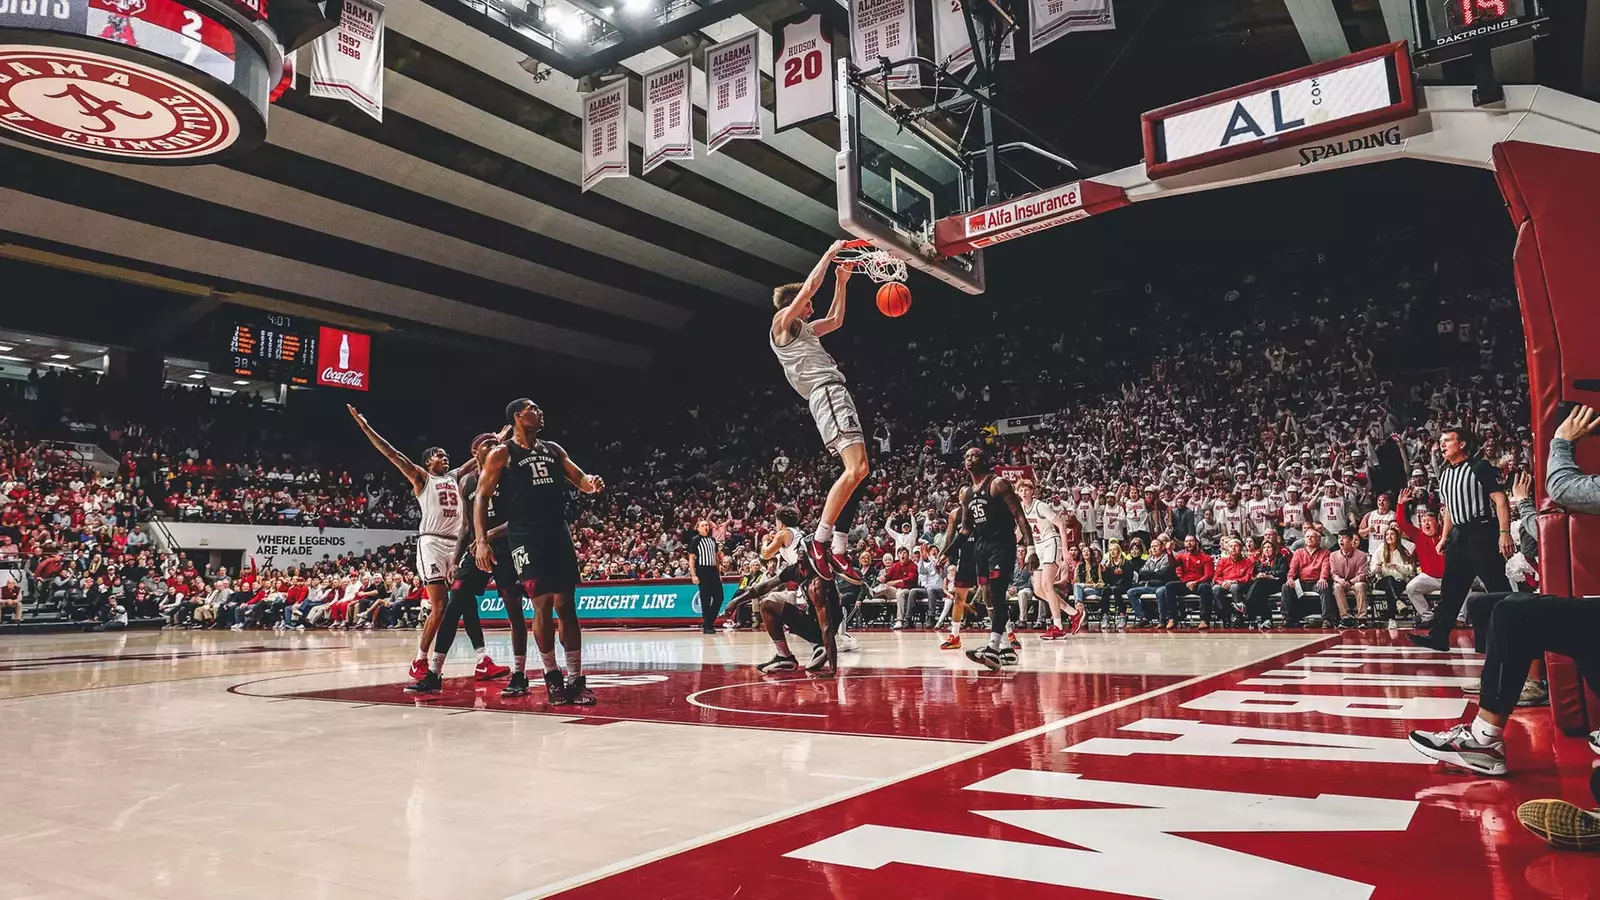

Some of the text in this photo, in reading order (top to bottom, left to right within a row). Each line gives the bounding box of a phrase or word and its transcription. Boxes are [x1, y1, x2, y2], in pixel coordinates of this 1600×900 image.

[343, 2, 373, 24] BAMA
[858, 9, 904, 29] SWEET SIXTEEN
[1049, 7, 1063, 15] 2011
[338, 32, 361, 48] 1997
[1437, 19, 1518, 45] DAKTRONICS
[337, 44, 361, 60] 1998
[713, 44, 751, 67] ALABAMA
[788, 39, 816, 56] HUDSON
[785, 50, 822, 88] 20
[650, 69, 684, 90] ALABAMA
[589, 92, 621, 113] ALABAMA
[60, 95, 211, 151] CRIMSON TIDE
[1219, 90, 1305, 147] AL
[1299, 126, 1401, 167] SPALDING
[988, 191, 1077, 229] Alfa Insurance
[995, 213, 1085, 242] Alfa Insurance
[268, 314, 291, 327] 4:07
[235, 357, 248, 368] 38
[529, 462, 549, 478] 15
[532, 478, 554, 486] AGGIES
[439, 491, 458, 506] 23
[971, 504, 985, 518] 35
[256, 535, 345, 546] WHERE LEGENDS
[256, 545, 312, 555] ARE MADE
[480, 597, 505, 612] OLD
[577, 594, 640, 610] FREIGHT
[642, 594, 677, 610] LINE
